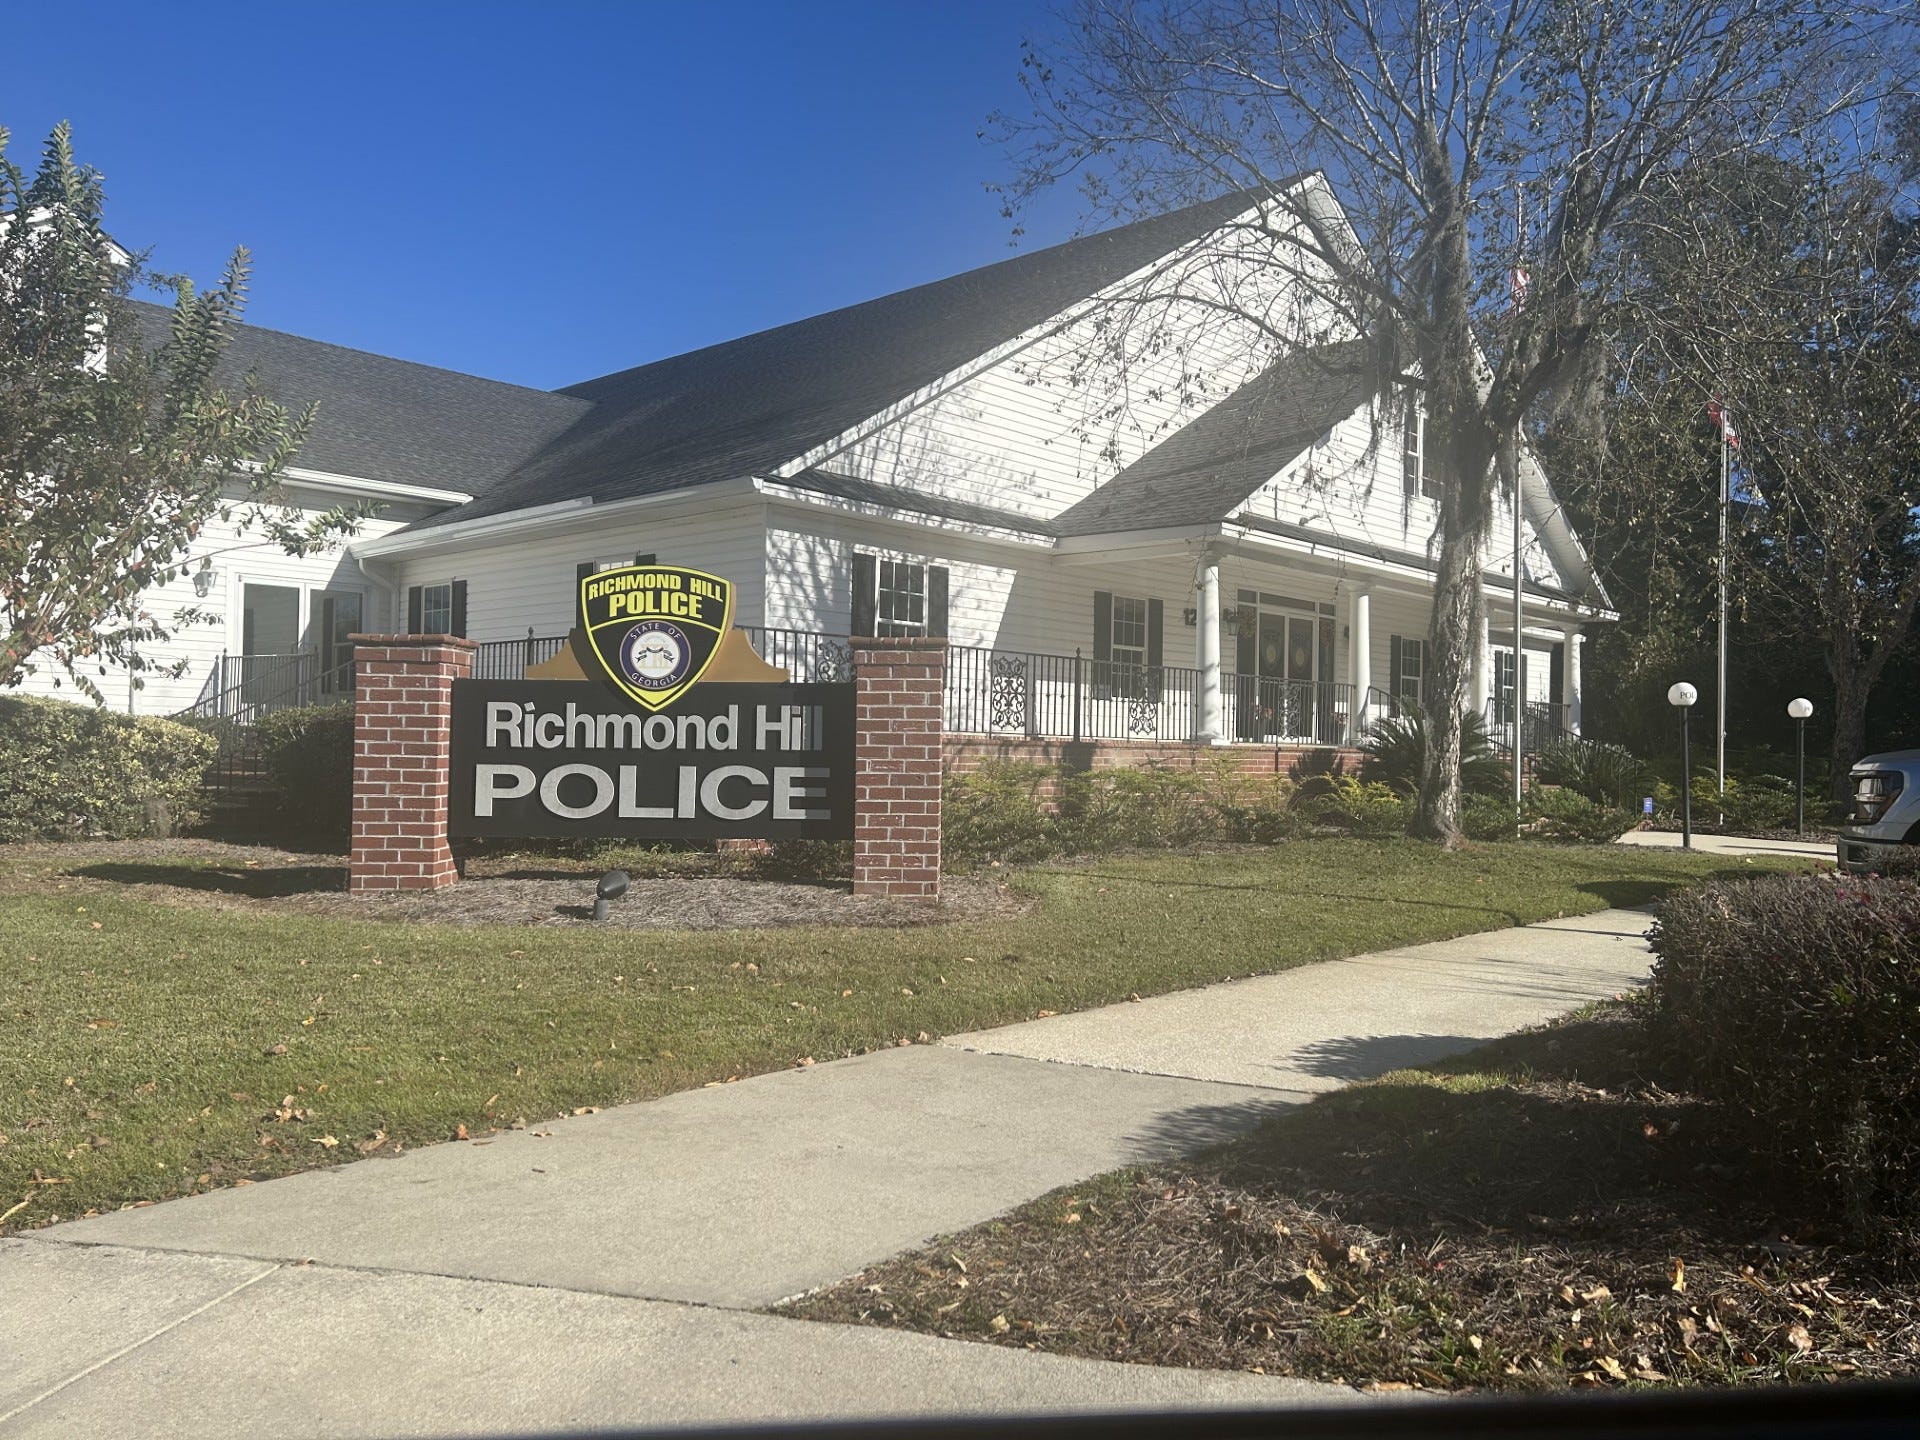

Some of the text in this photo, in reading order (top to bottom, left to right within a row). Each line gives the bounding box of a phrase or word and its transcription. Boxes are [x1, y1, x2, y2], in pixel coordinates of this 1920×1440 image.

[590, 575, 723, 602] RICHMOND HILL
[610, 591, 702, 618] POLICE
[630, 623, 681, 639] STATE OF
[631, 672, 678, 687] GEORGIA
[486, 702, 823, 750] Richmond Hill
[474, 763, 831, 820] POLICE
